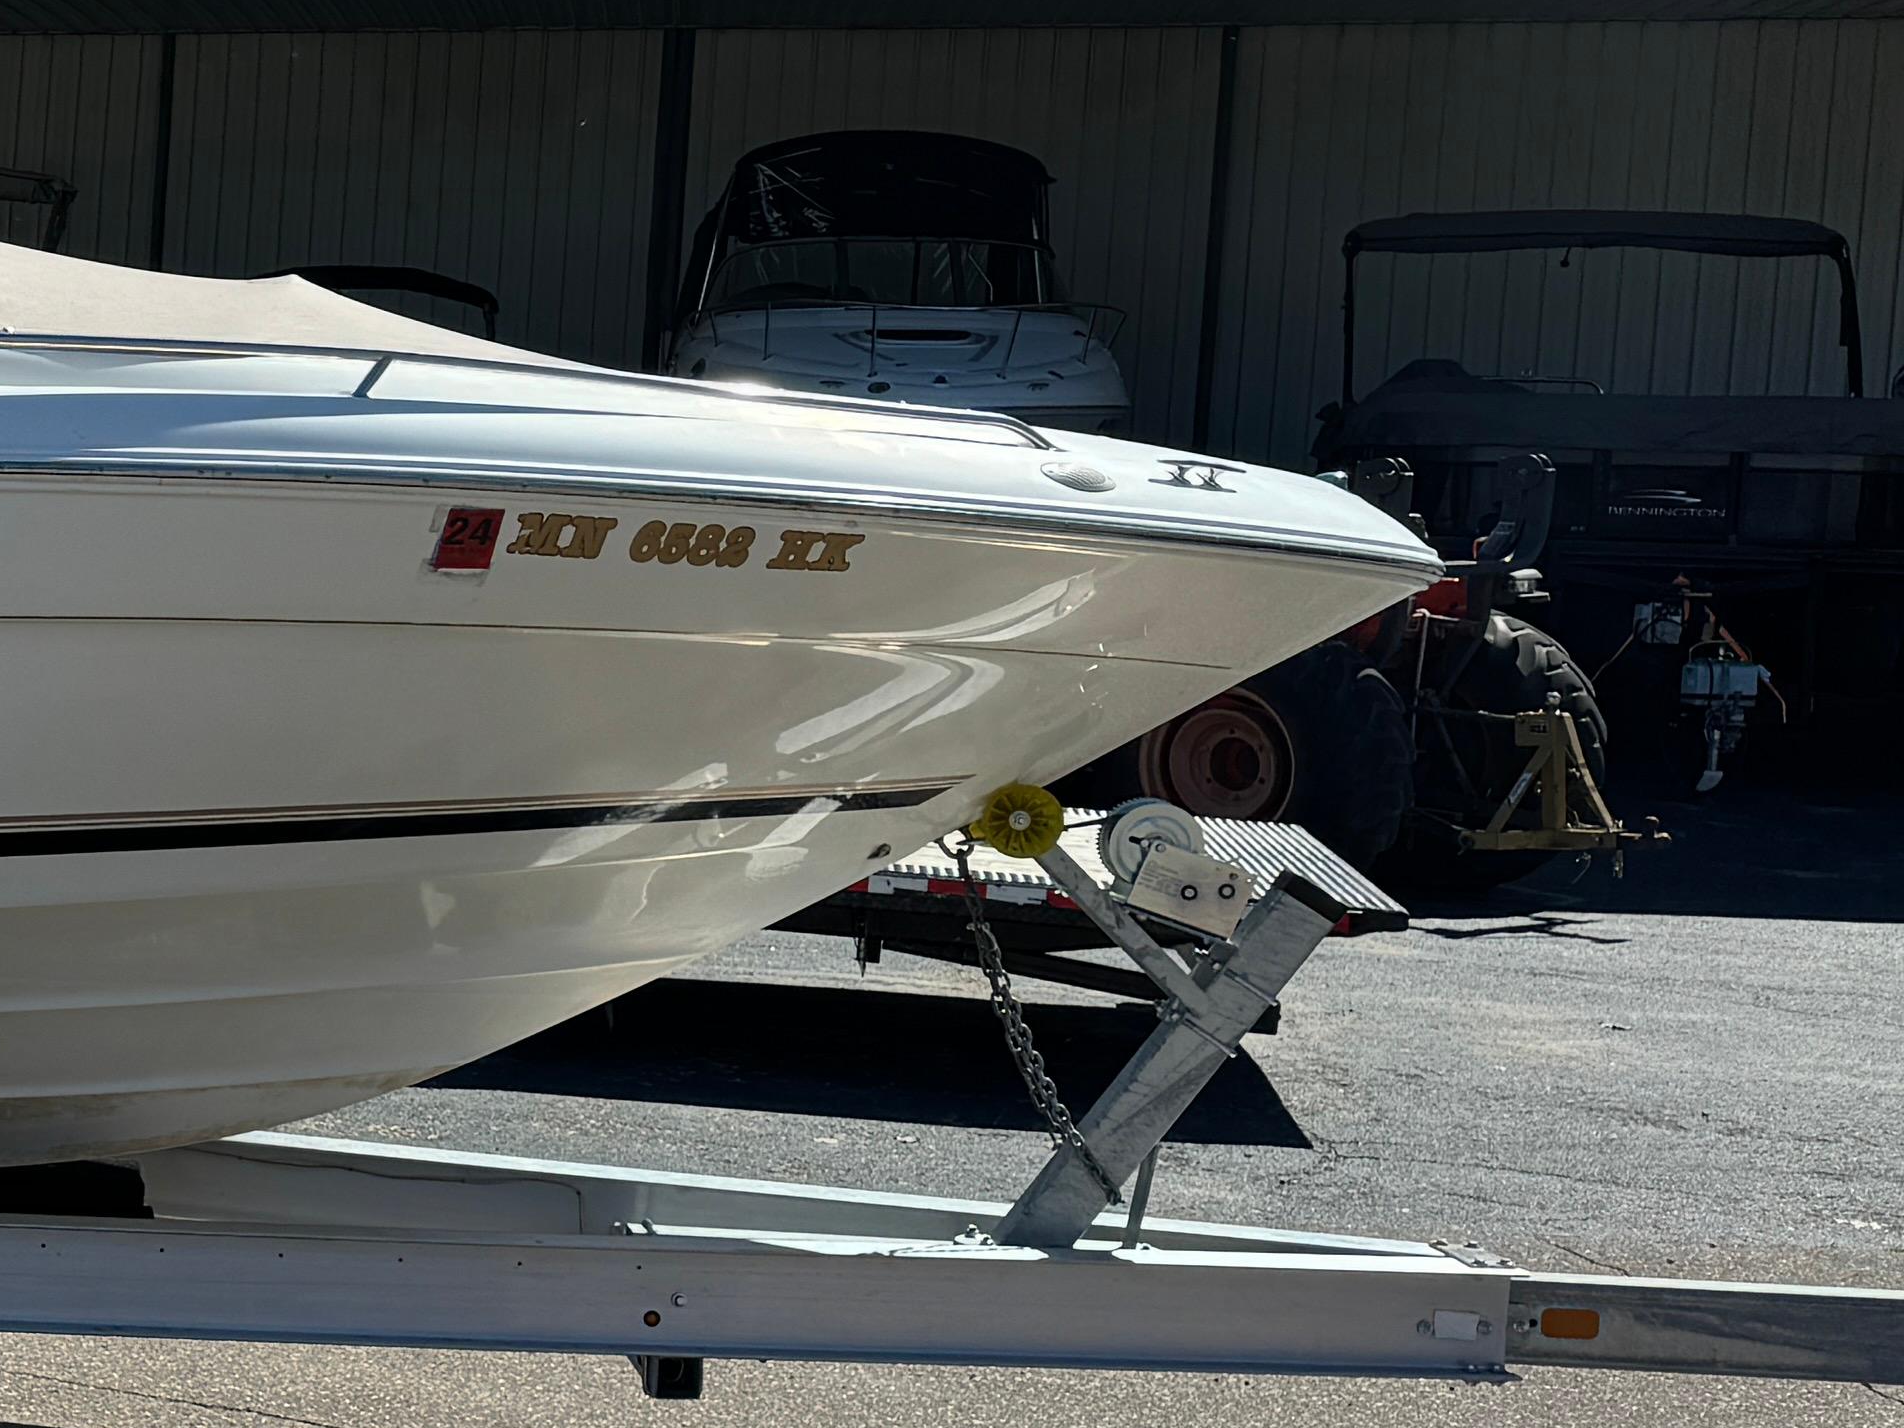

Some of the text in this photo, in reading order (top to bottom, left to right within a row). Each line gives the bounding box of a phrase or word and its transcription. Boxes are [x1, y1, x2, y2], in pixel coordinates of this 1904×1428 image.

[444, 516, 494, 546] 24
[506, 512, 866, 572] MN 6582 HK
